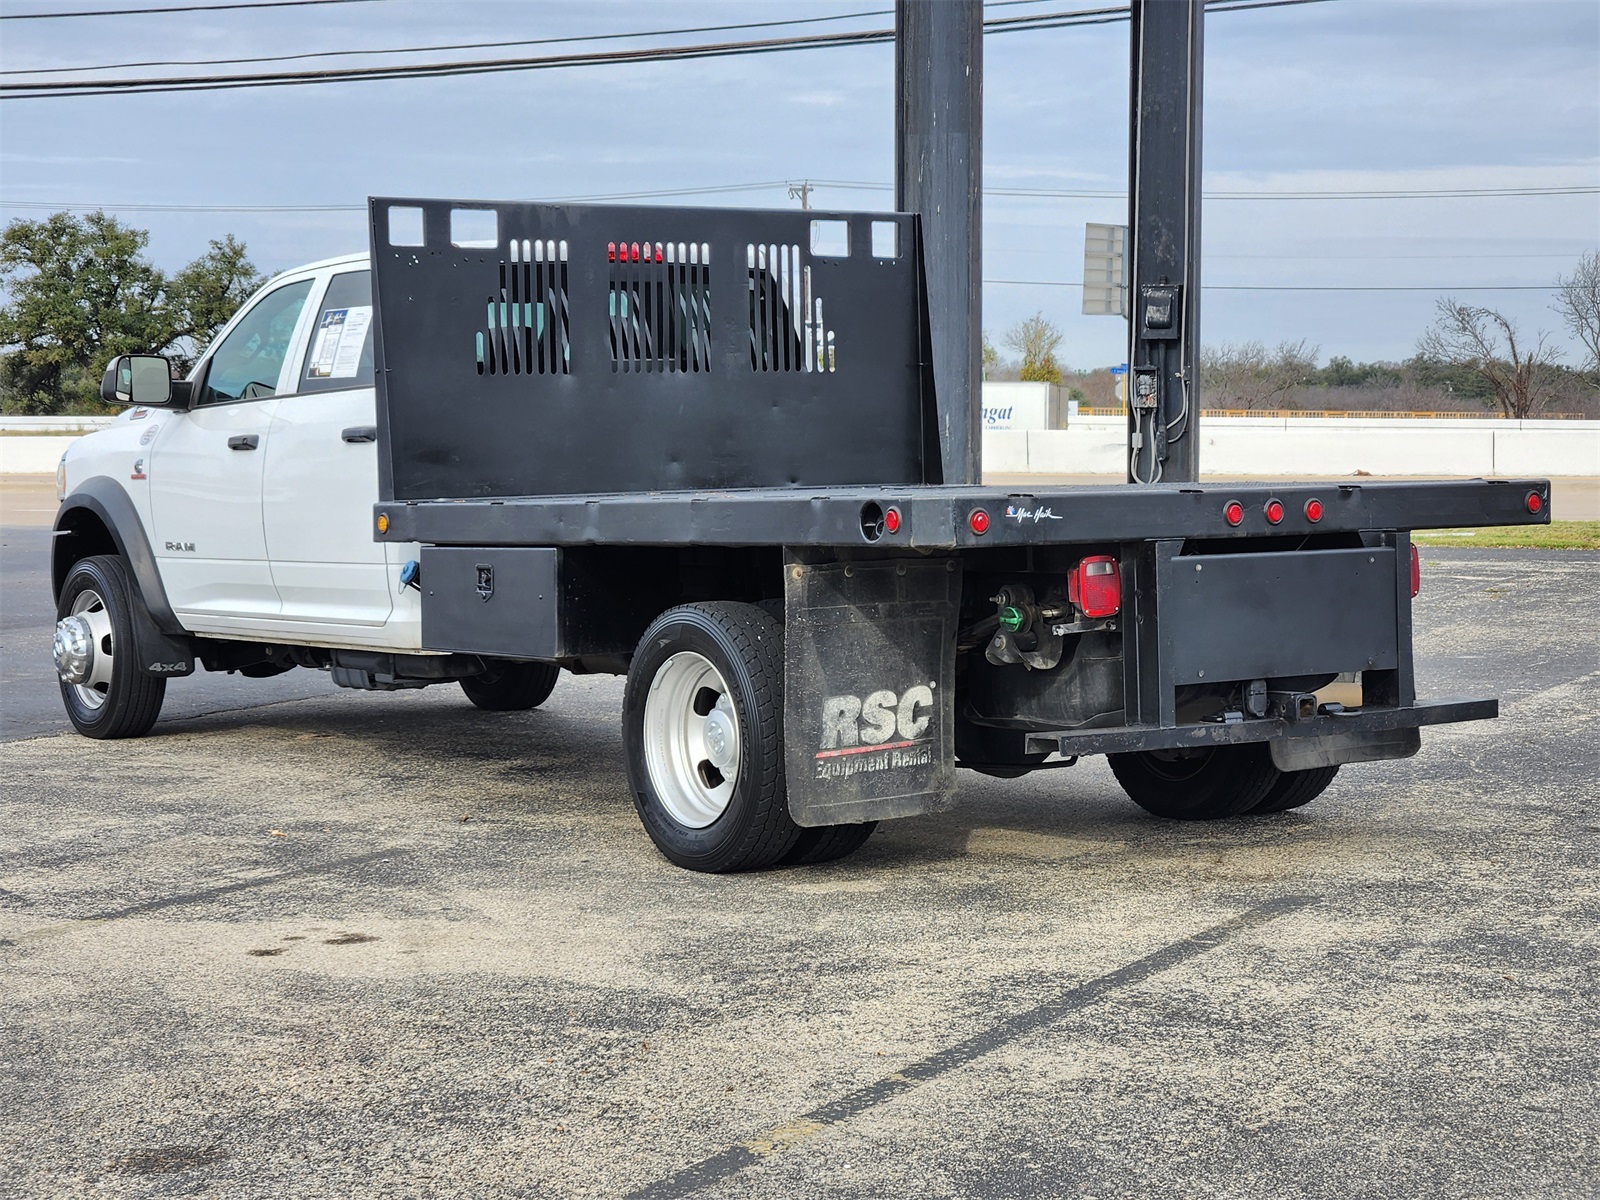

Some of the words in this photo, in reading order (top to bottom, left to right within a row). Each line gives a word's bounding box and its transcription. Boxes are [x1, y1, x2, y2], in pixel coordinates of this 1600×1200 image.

[165, 541, 196, 552] RAM
[149, 661, 187, 672] 4x4
[819, 685, 933, 750] RSC
[815, 757, 888, 780] Equipment
[890, 748, 932, 769] Rental
